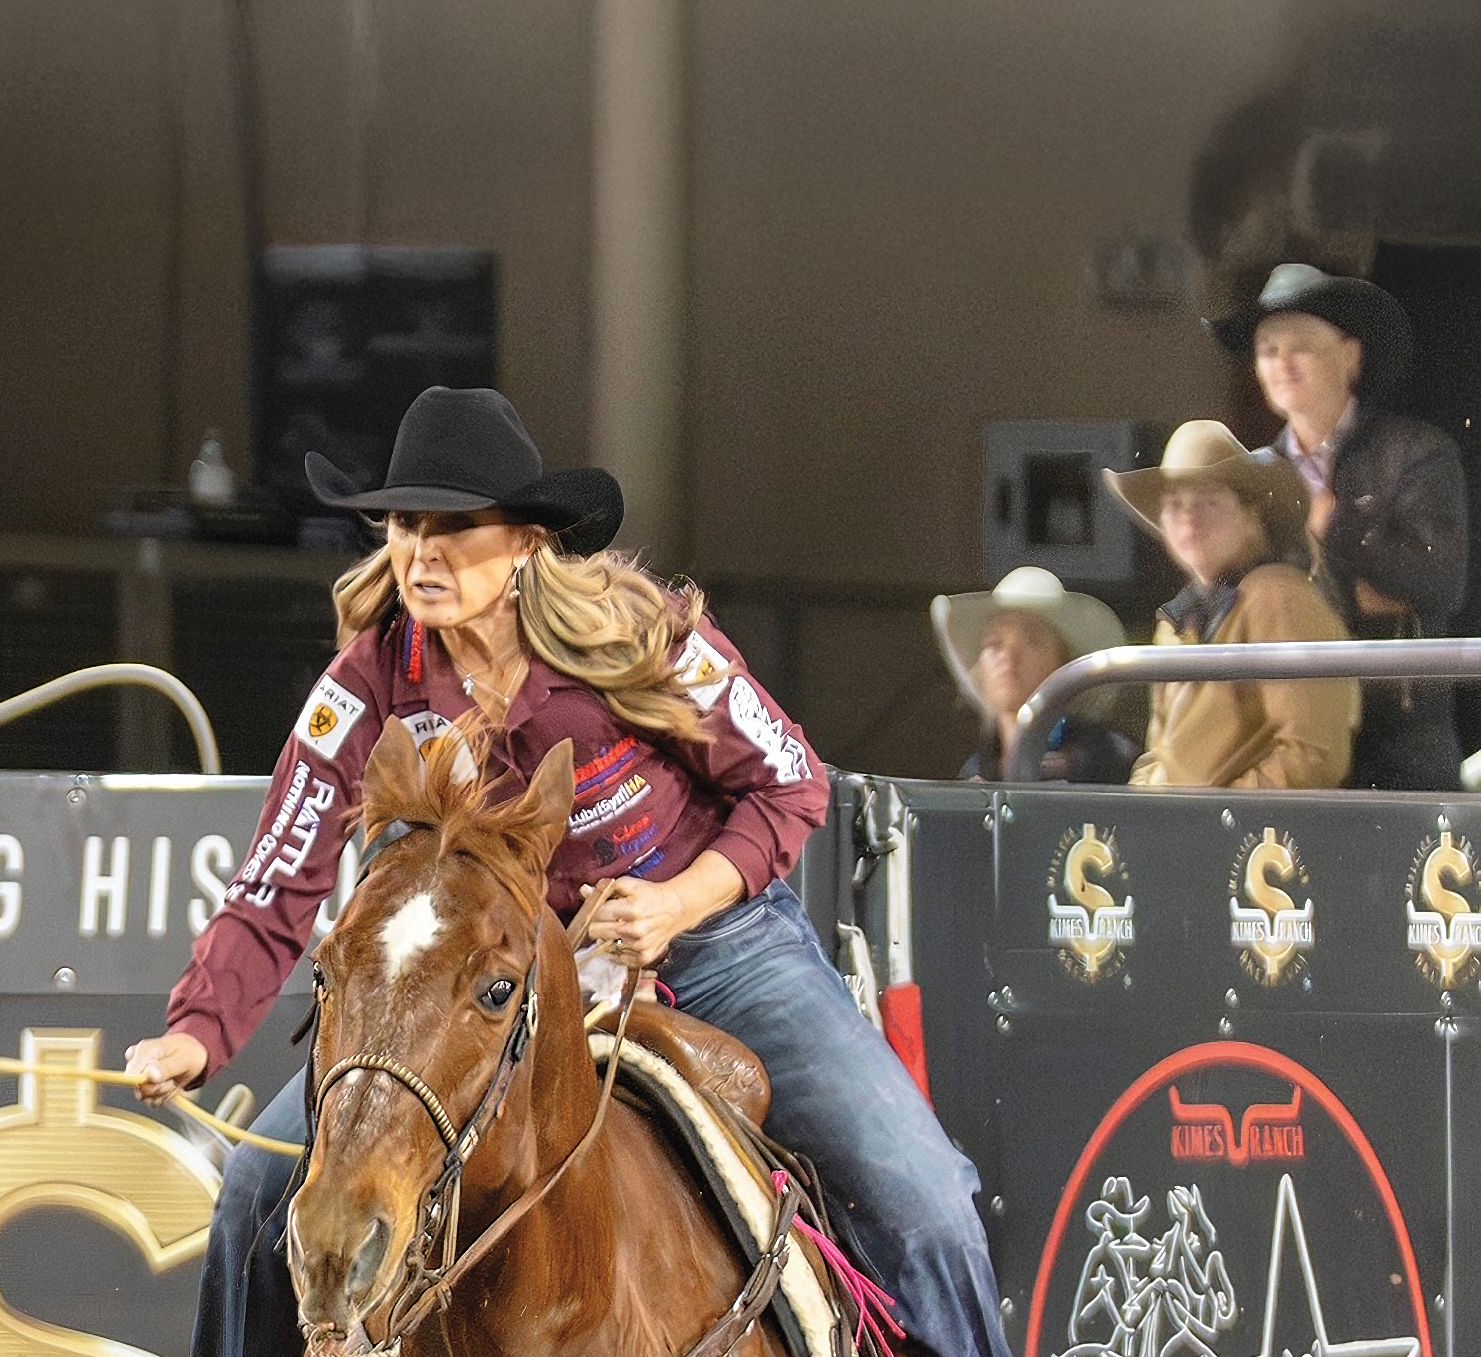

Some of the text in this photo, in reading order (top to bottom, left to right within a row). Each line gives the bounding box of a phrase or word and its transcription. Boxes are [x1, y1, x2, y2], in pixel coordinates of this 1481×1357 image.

[319, 685, 360, 715] ARIAT
[414, 717, 448, 734] RIA
[244, 777, 336, 908] RATTLR
[1171, 1125, 1224, 1157] KIMES
